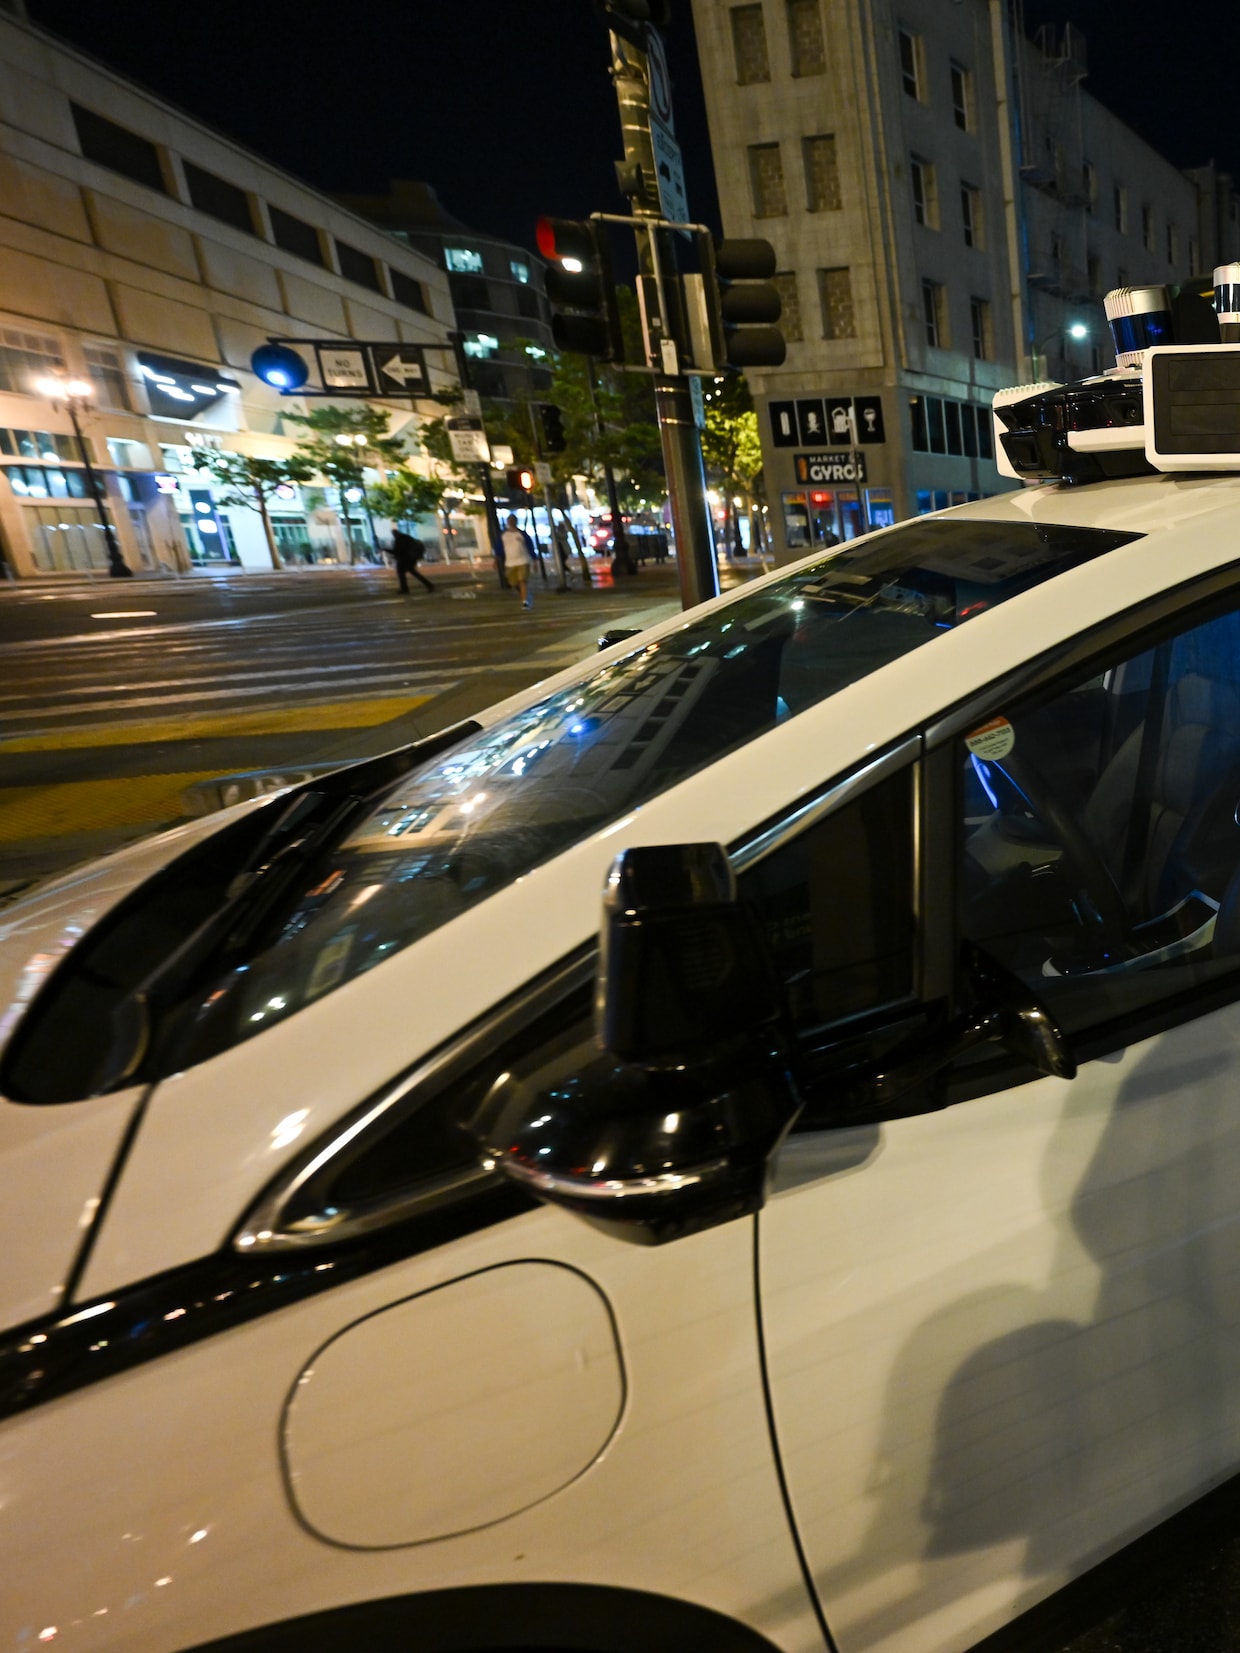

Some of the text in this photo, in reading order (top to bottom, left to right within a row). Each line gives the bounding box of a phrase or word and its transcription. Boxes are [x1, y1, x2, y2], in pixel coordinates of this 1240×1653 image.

[335, 359, 351, 369] NO
[327, 369, 363, 378] TURNS
[809, 454, 846, 463] MARKET
[809, 463, 864, 481] GYROS
